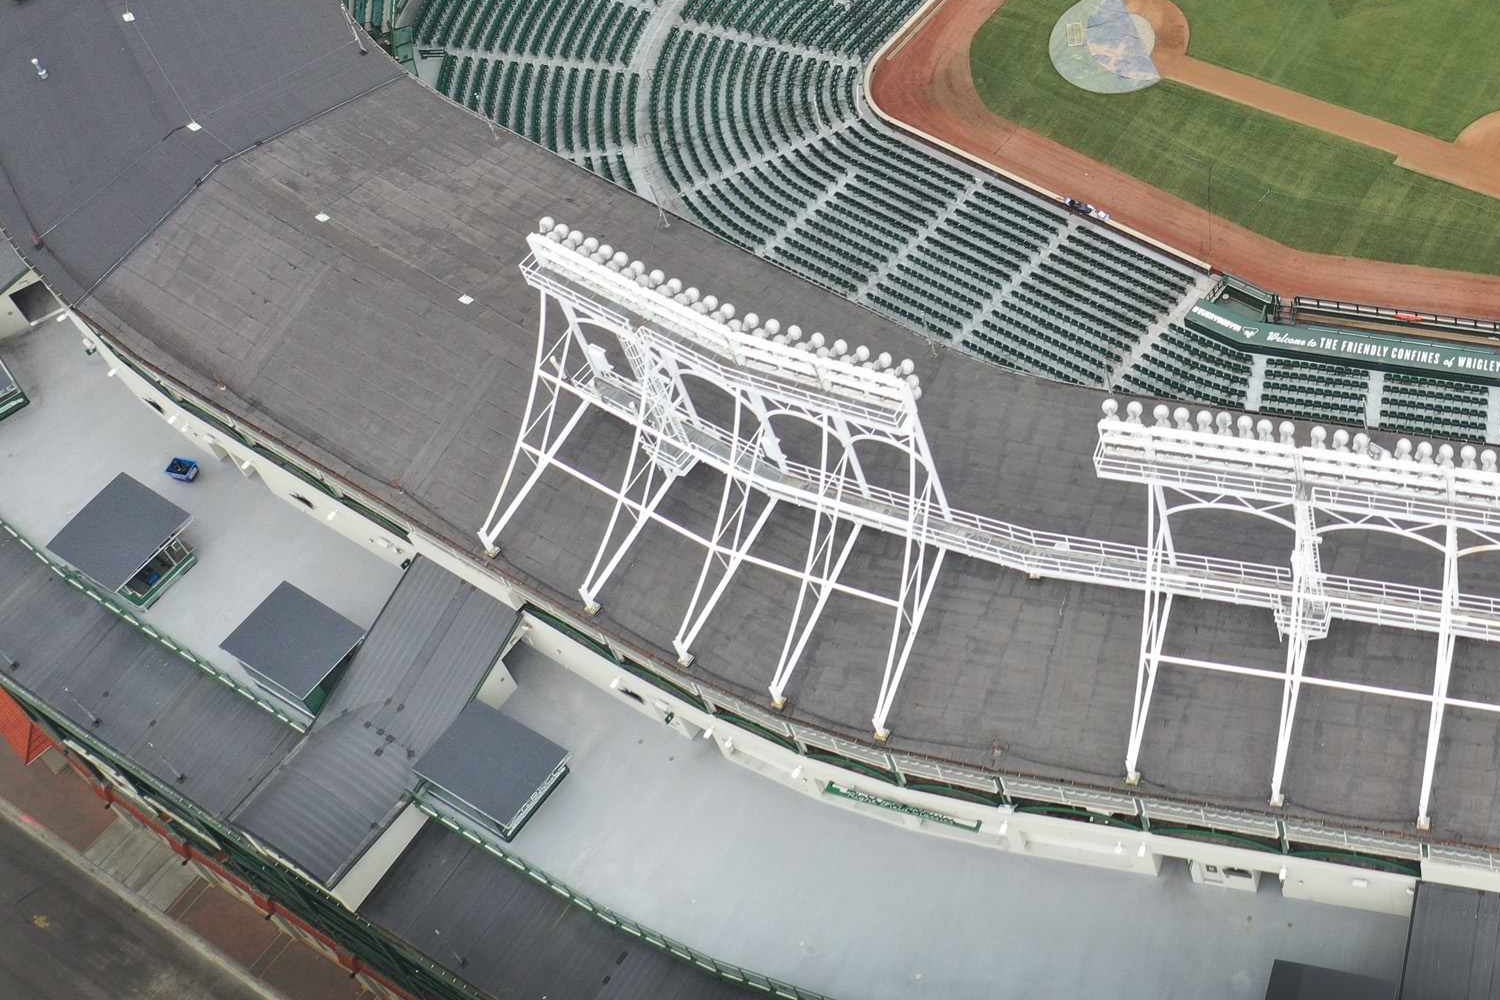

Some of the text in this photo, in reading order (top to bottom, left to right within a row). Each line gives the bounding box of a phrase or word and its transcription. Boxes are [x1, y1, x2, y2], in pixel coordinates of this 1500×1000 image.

[1266, 331, 1306, 346] Welcome
[1306, 340, 1318, 348] to
[1319, 337, 1339, 351] THE
[1340, 340, 1390, 358] FRIENDLY
[1390, 347, 1441, 365] CONFINES
[1442, 356, 1456, 368] of
